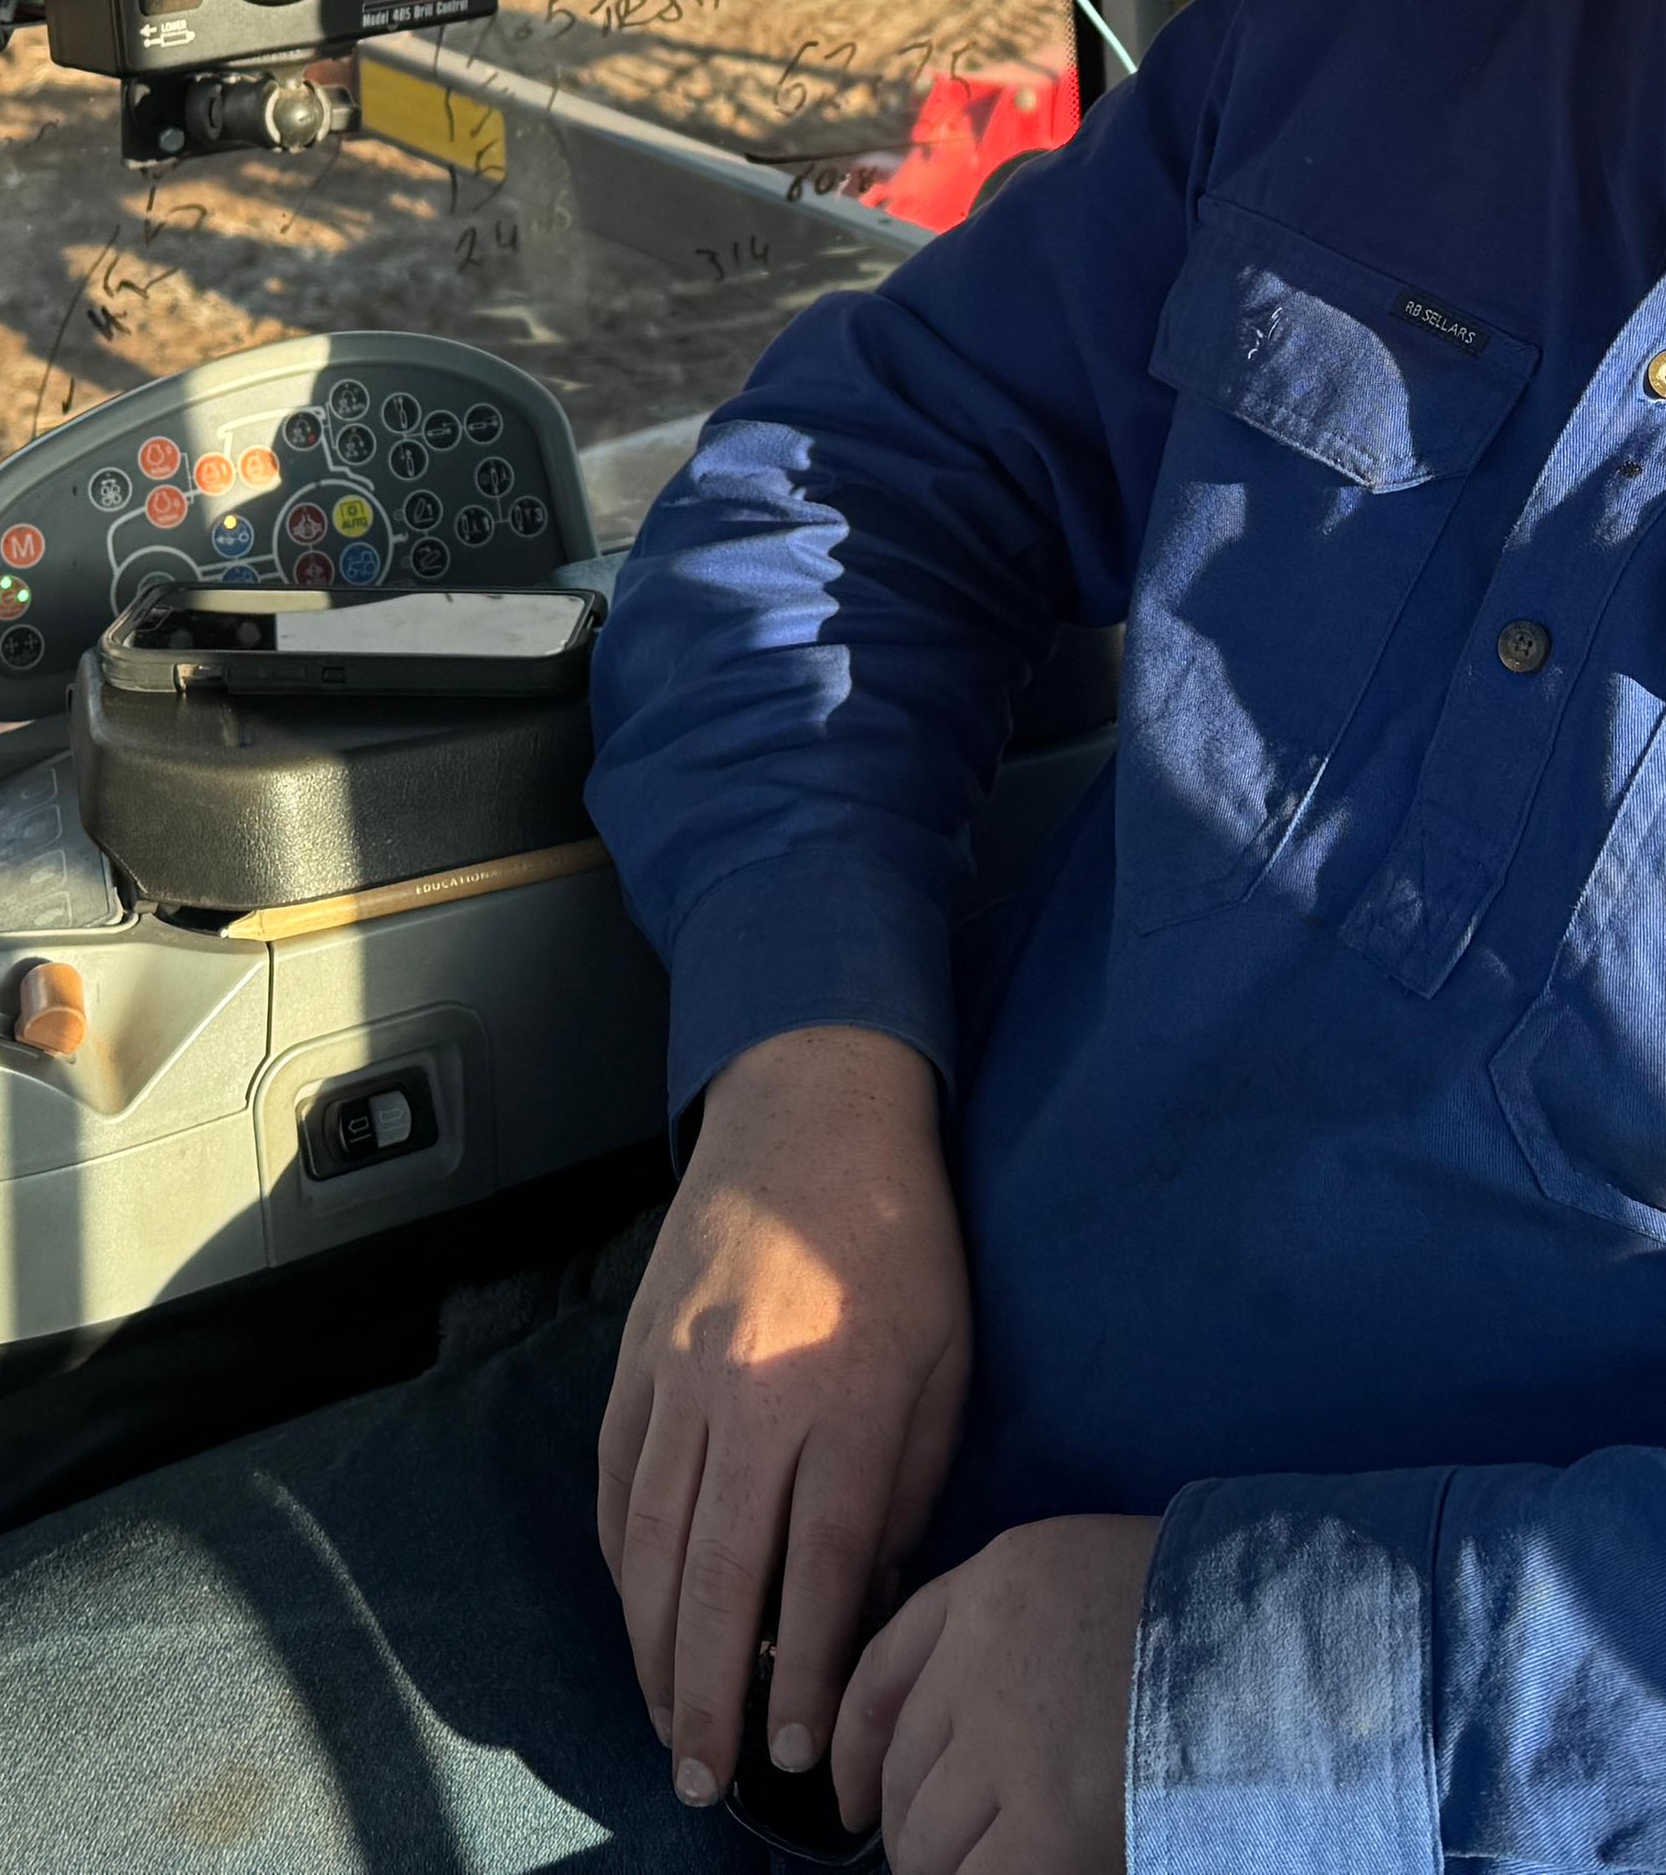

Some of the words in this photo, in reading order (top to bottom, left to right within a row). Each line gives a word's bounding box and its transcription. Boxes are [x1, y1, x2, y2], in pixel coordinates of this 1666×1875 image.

[161, 19, 188, 33] LOWER
[362, 10, 390, 29] Model
[414, 2, 435, 20] Drill
[1405, 301, 1422, 317] RB
[1422, 309, 1477, 345] SELLARS
[342, 517, 369, 531] AUTO
[11, 535, 35, 558] M
